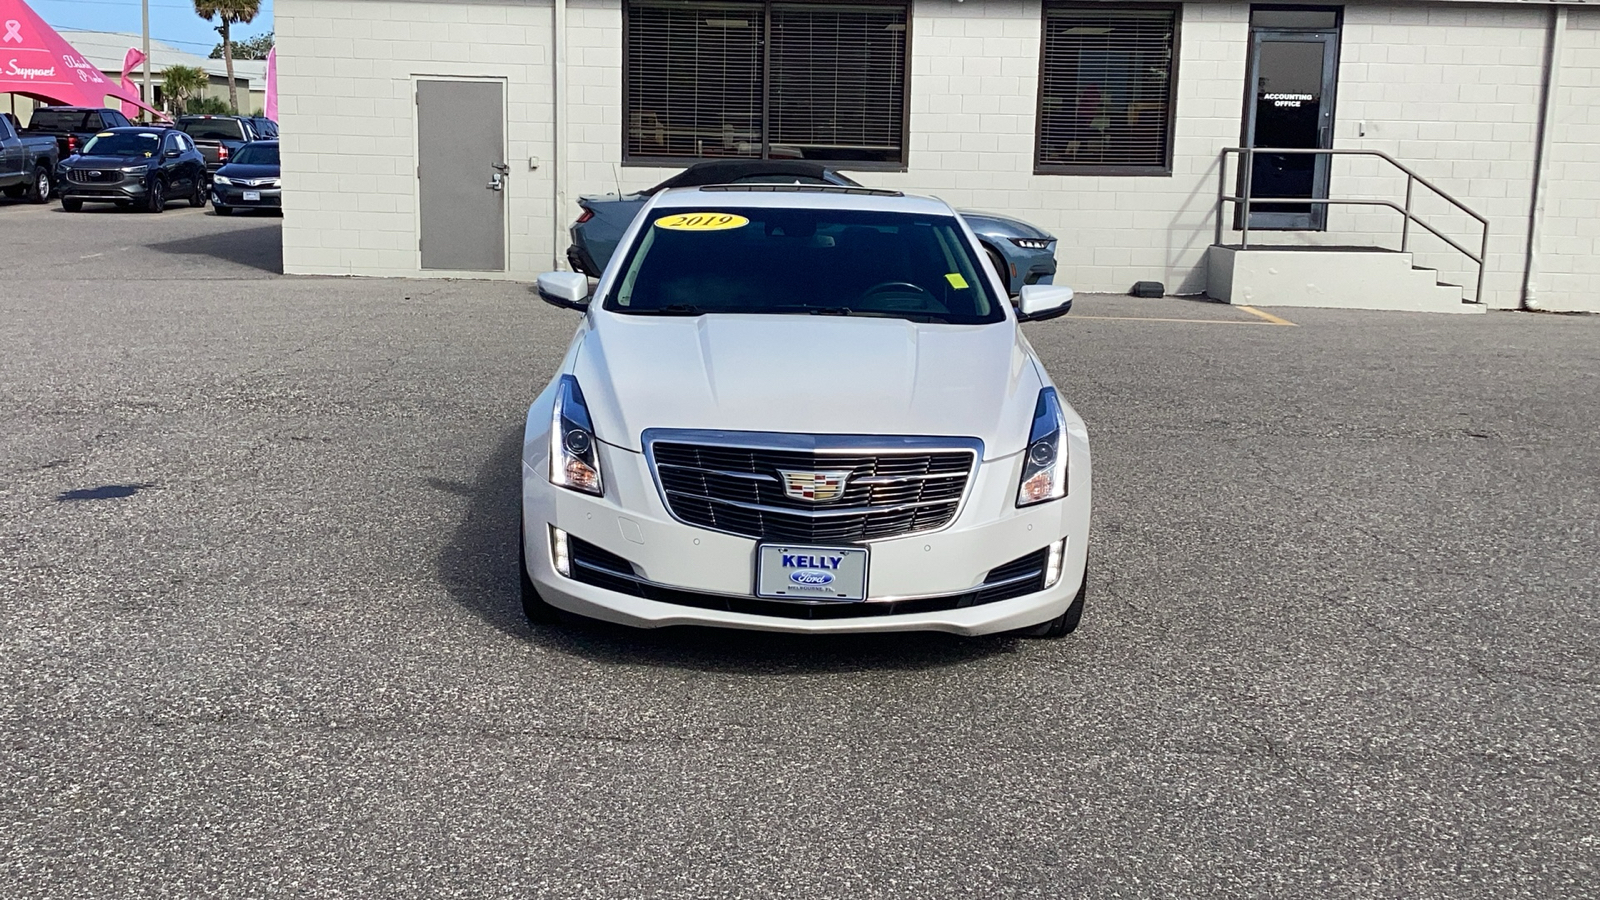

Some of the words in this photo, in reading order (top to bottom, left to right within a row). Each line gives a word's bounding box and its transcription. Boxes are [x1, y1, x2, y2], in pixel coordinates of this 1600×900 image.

[5, 58, 56, 79] Support
[1264, 93, 1312, 101] ACCOUNTING
[669, 216, 733, 227] 2019
[782, 554, 843, 570] KELLY
[798, 571, 825, 584] Ford
